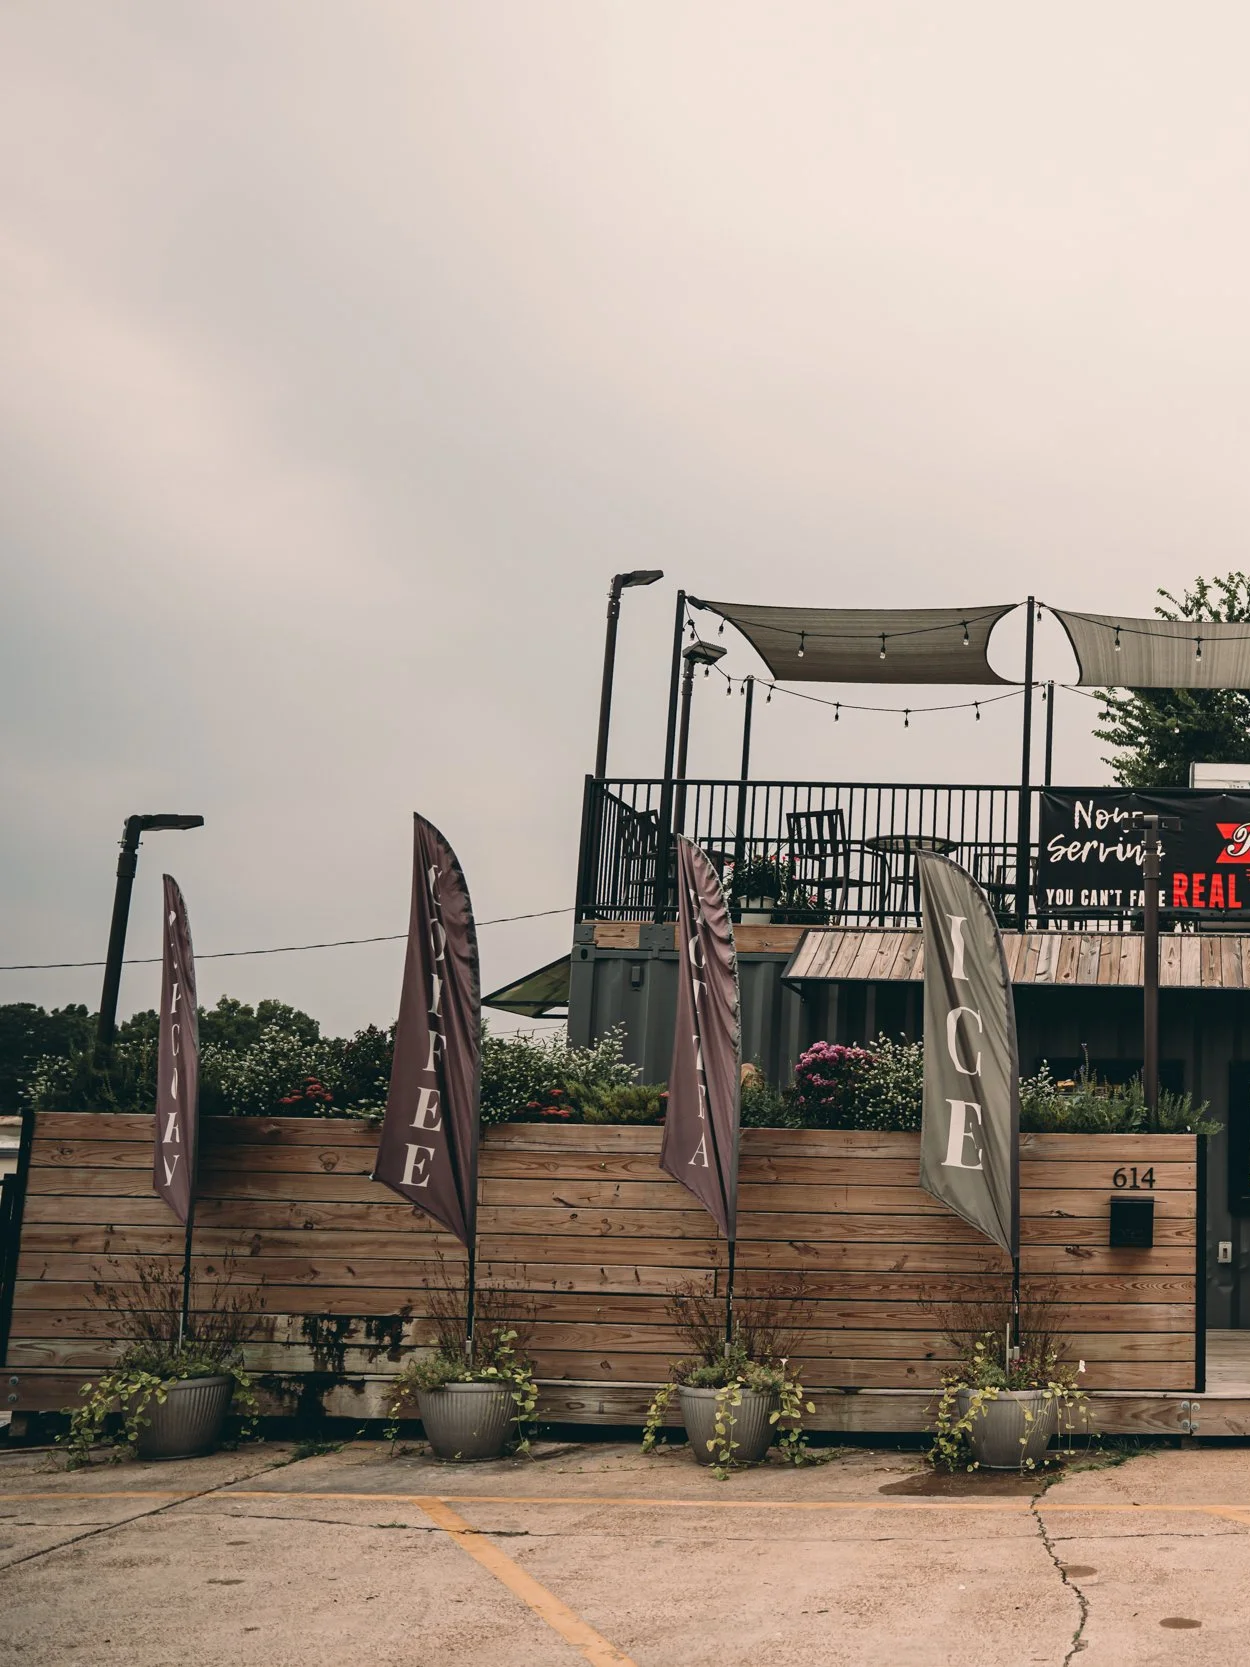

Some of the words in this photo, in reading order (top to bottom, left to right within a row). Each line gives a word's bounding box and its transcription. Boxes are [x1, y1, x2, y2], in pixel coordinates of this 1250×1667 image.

[1046, 888, 1074, 906] YOU
[1080, 889, 1123, 907] CAN'T
[1129, 890, 1166, 908] FAE
[1173, 873, 1242, 908] REAL
[941, 913, 983, 1170] ICE
[1112, 1167, 1156, 1189] 614
